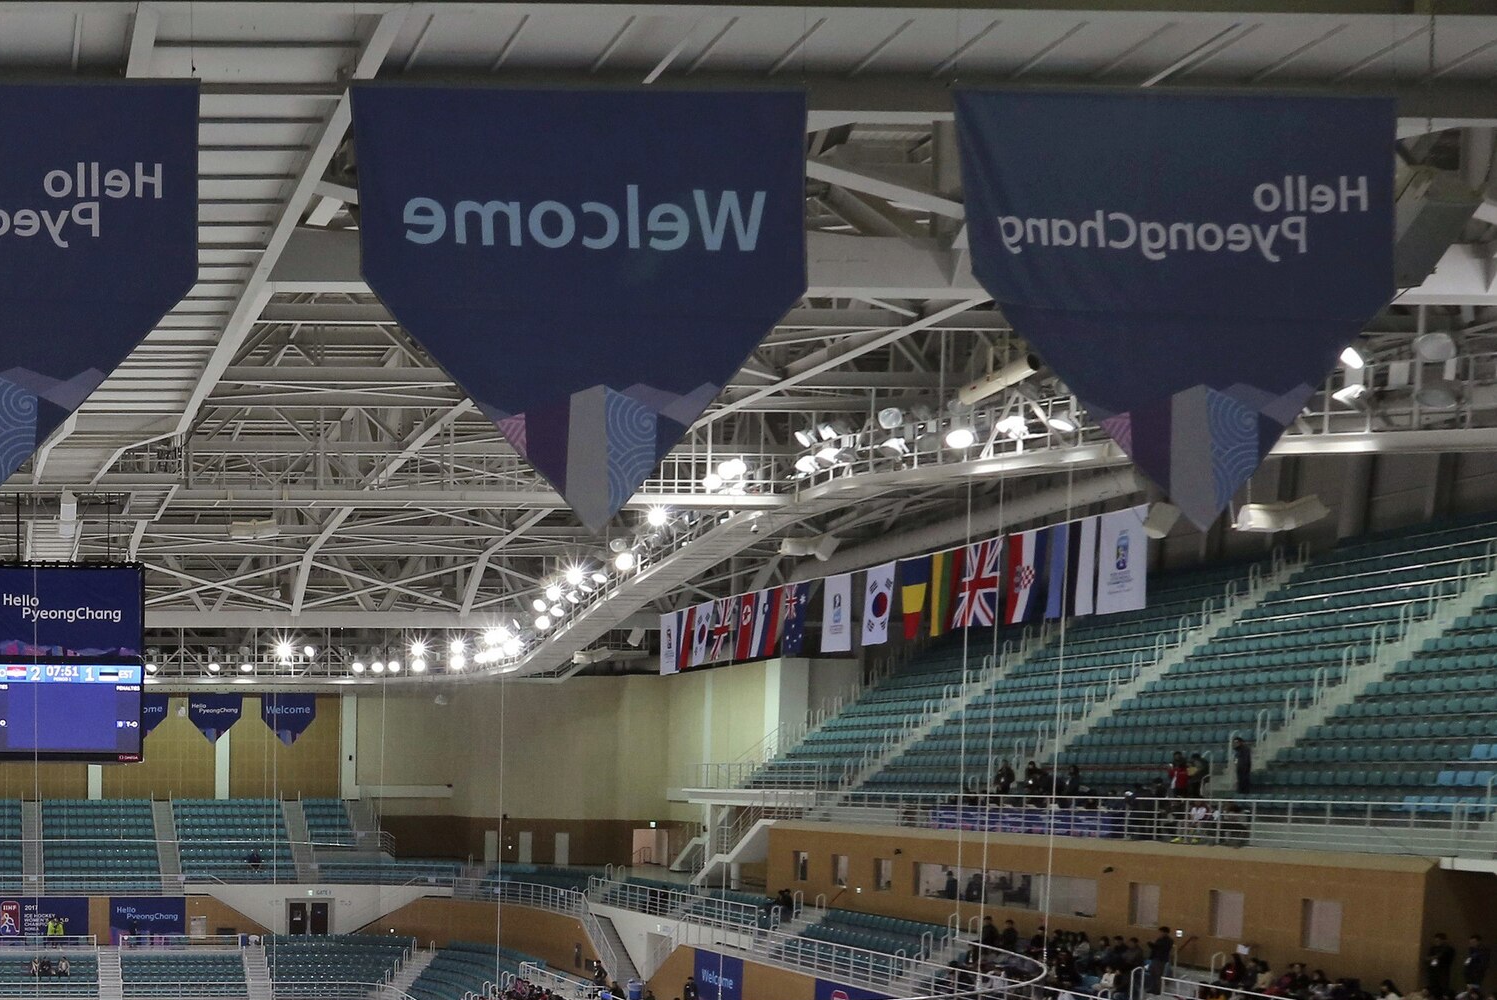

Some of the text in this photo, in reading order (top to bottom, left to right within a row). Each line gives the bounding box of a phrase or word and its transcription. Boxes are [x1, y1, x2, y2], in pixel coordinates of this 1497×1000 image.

[3, 593, 39, 607] Hello
[22, 607, 122, 622] PyeongChang
[30, 667, 41, 681] 2
[85, 667, 95, 682] 1
[118, 670, 134, 679] EST
[266, 705, 311, 714] Welcome
[126, 913, 179, 921] PyeongChang
[701, 968, 734, 990] Welcome
